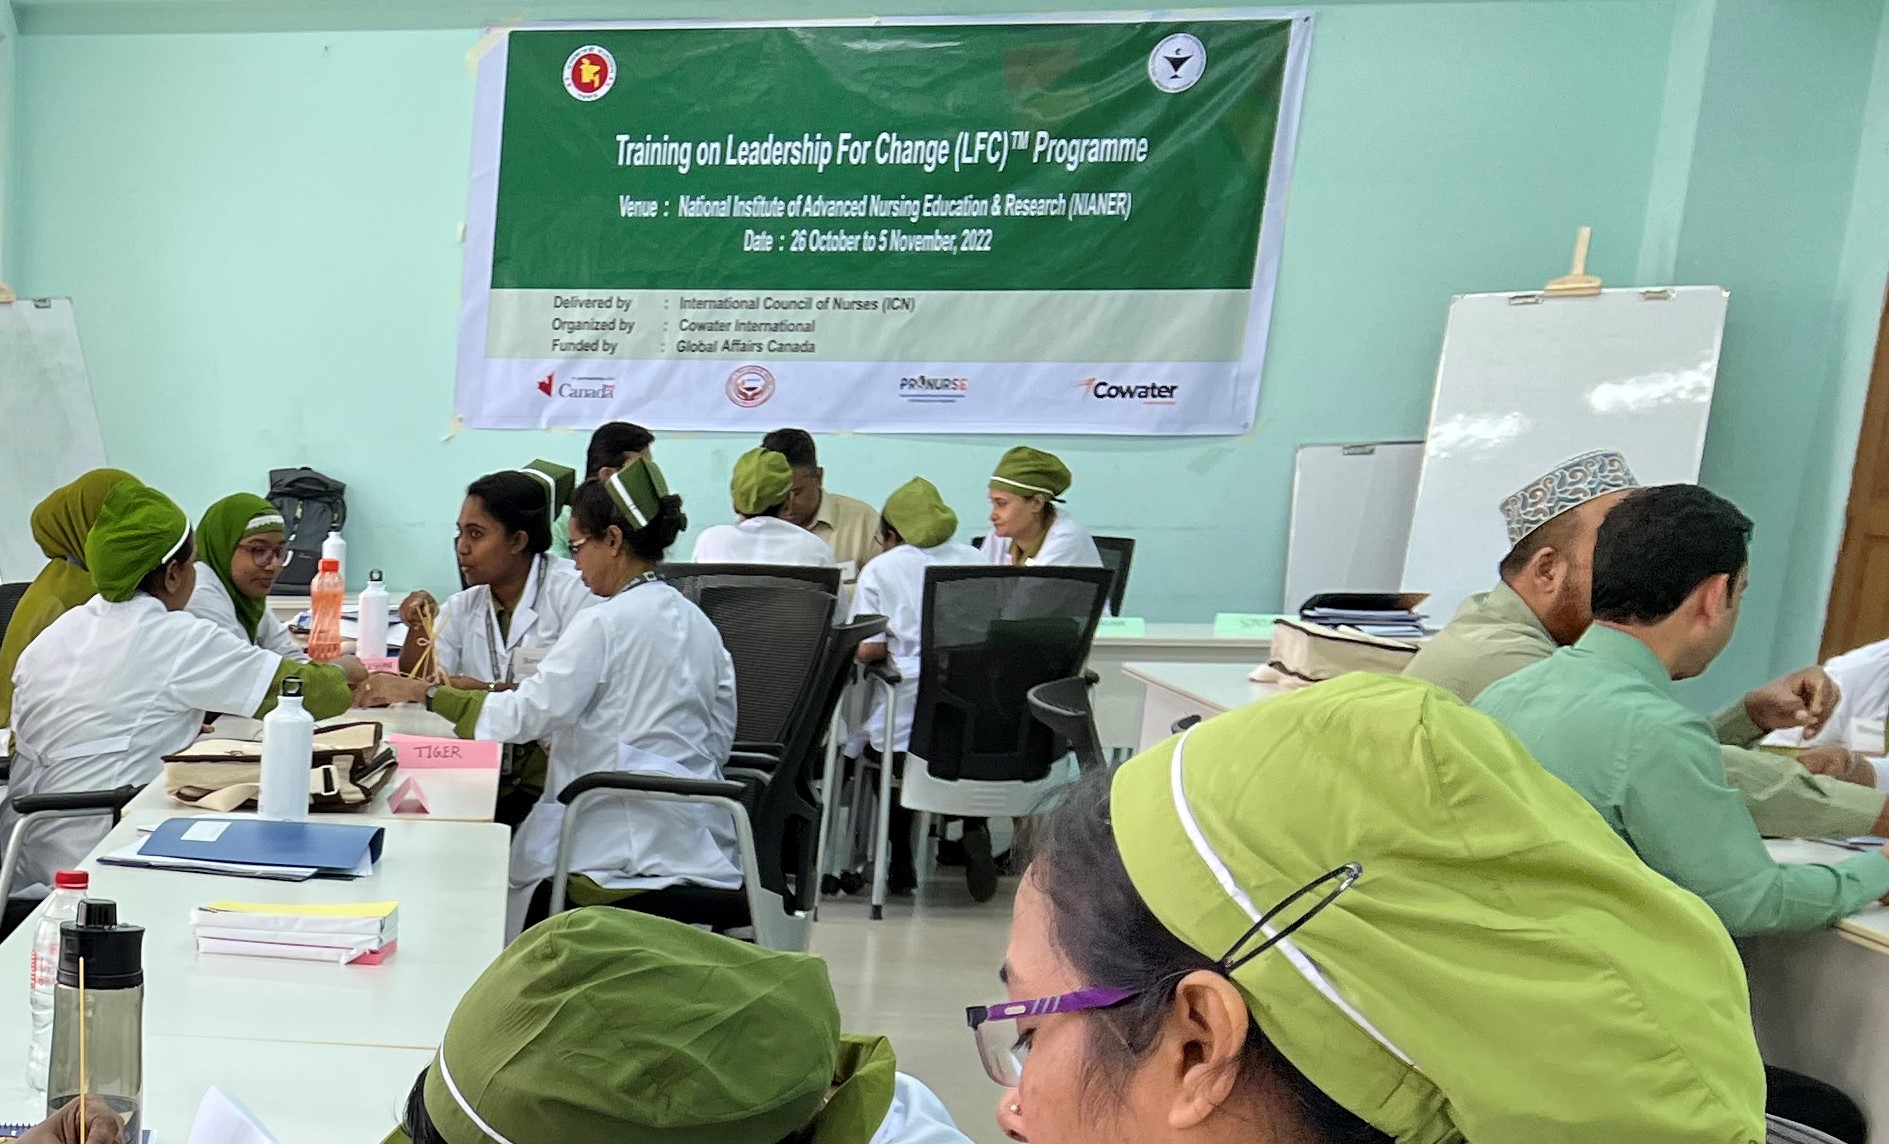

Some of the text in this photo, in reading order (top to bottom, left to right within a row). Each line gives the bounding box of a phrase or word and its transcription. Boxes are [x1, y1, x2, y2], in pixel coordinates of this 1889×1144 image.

[616, 133, 693, 174] Training
[696, 141, 722, 167] on
[725, 132, 833, 173] Leadership
[837, 132, 872, 166] For
[875, 131, 950, 173] Change
[1033, 130, 1149, 172] Programme
[619, 194, 659, 218] Venue
[678, 194, 731, 218] National
[732, 194, 786, 218] Institute
[787, 194, 804, 218] of
[802, 194, 868, 218] Advanced
[869, 194, 920, 223] Nursing
[923, 194, 989, 217] Education
[991, 193, 1002, 217] &
[1004, 192, 1066, 217] Research
[1068, 191, 1132, 221] (NIANER)
[743, 228, 774, 252] Date
[789, 228, 807, 252] 26
[808, 228, 861, 252] October
[862, 229, 876, 252] to
[878, 229, 888, 252] 5
[889, 228, 957, 255] November,
[960, 228, 993, 252] 2022
[553, 295, 614, 310] Delivered
[616, 295, 632, 312] by
[679, 296, 760, 311] International
[763, 296, 813, 311] Council
[815, 296, 831, 311] of
[832, 297, 879, 311] Nurses
[882, 296, 916, 314] (ICN)
[551, 317, 616, 333] Organized
[619, 318, 635, 335] by
[678, 318, 732, 332] Cowater
[734, 319, 816, 333] International
[551, 338, 599, 352] Funded
[602, 338, 618, 355] by
[676, 339, 718, 353] Global
[721, 338, 764, 353] Affairs
[767, 339, 816, 353] Canada
[558, 382, 615, 399] Canada
[1092, 381, 1180, 399] Cowater
[413, 745, 462, 760] TIGER
